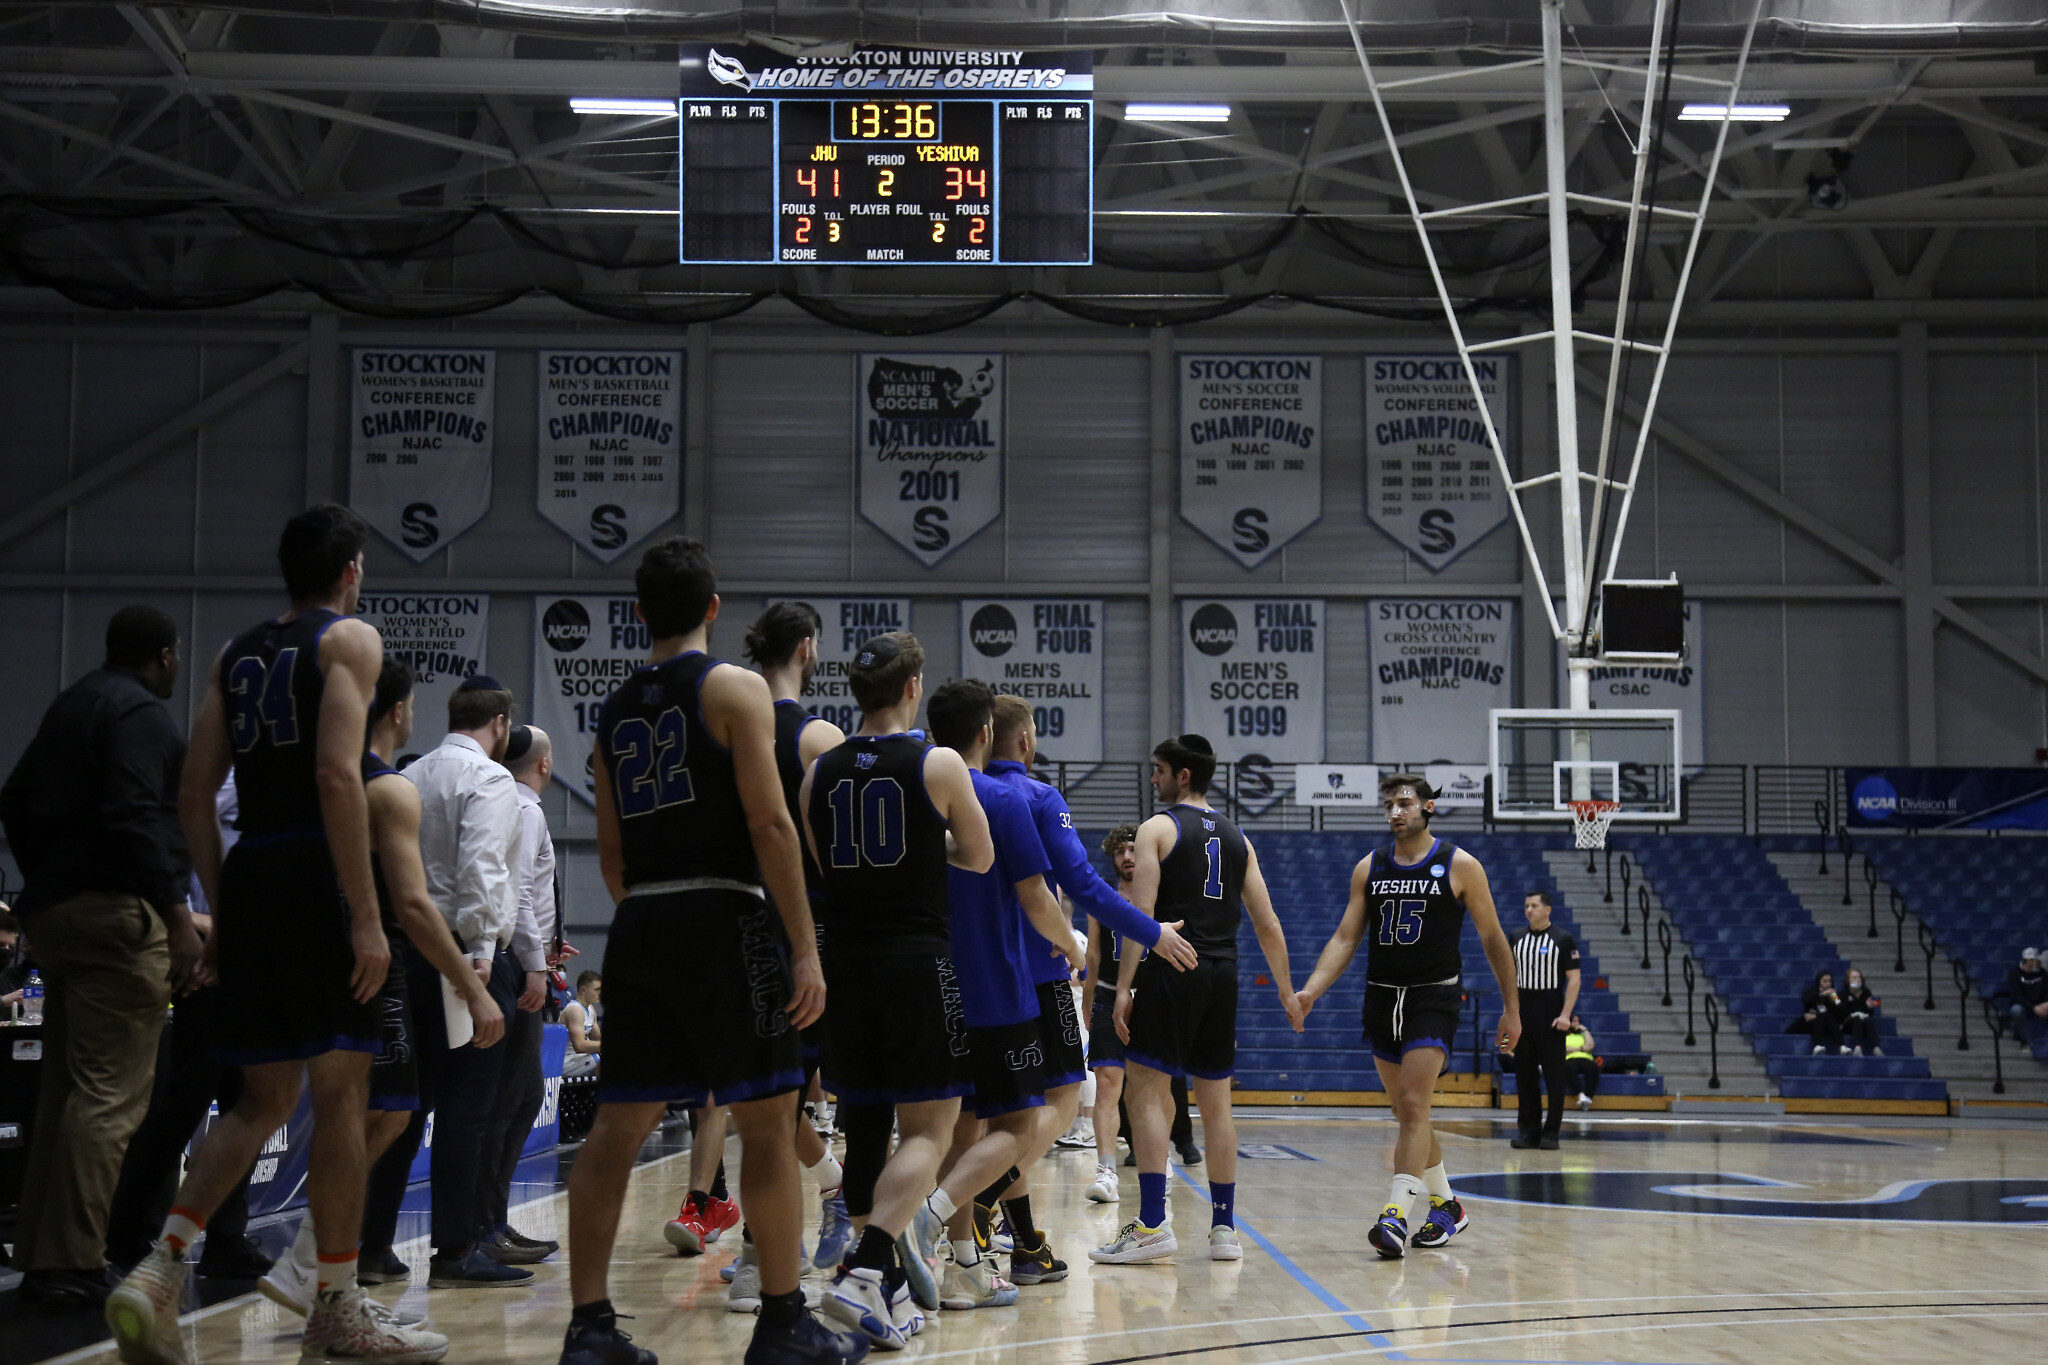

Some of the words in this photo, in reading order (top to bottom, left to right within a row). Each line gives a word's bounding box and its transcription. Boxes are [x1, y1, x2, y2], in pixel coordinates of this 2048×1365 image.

[796, 51, 901, 65] STOCKTON
[909, 51, 1023, 65] UNIVERSITY
[756, 67, 839, 88] HOME
[842, 68, 882, 88] OF
[885, 69, 940, 88] THE
[943, 69, 1067, 88] OSPREYS
[690, 104, 712, 118] PLYR
[721, 104, 738, 118] FLS
[748, 105, 766, 118] PTS
[1006, 106, 1028, 119] PLYR
[1037, 106, 1053, 119] FLS
[1065, 106, 1082, 119] PTS
[851, 104, 935, 138] 13:36
[811, 145, 838, 161] JHU
[867, 154, 906, 166] PERIOD
[916, 145, 980, 162] YESHIVA
[877, 170, 895, 197] 2
[945, 167, 986, 200] 34
[782, 203, 816, 215] FOULS
[850, 203, 890, 215] PLAYER
[896, 203, 923, 215] FOUL
[956, 204, 990, 216] FOULS
[795, 217, 812, 243] 2
[828, 222, 841, 243] 3
[932, 223, 946, 243] 2
[969, 217, 986, 244] 2
[782, 248, 817, 260] SCORE
[867, 249, 904, 260] MATCH
[956, 249, 991, 261] SCORE
[361, 353, 485, 374] STOCKTON
[548, 355, 671, 376] STOCKTON
[1189, 360, 1311, 380] STOCKTON
[1374, 360, 1497, 381] STOCKTON
[361, 375, 417, 388] WOMEN'S
[420, 376, 485, 388] BASKETBALL
[548, 378, 590, 390] MEN'S
[593, 379, 671, 391] BASKETBALL
[880, 370, 918, 382] NCAA
[920, 370, 936, 383] III
[883, 383, 932, 397] MEN'S
[1202, 383, 1243, 395] MEN'S
[1246, 383, 1300, 395] SOCCER
[1375, 383, 1430, 394] WOMEN'S
[1433, 383, 1497, 394] VOLLEYALL
[370, 391, 476, 405] CONFERENCE
[557, 393, 662, 407] CONFERENCE
[876, 397, 939, 410] SOCCER
[1198, 397, 1303, 411] CONFERENCE
[1384, 398, 1488, 412] CONFERENC
[361, 409, 487, 443] CHAMPIONS
[548, 411, 674, 445] CHAMPIONS
[868, 419, 996, 448] NATIONAL
[1190, 415, 1314, 449] CHAMPIONS
[402, 436, 442, 450] NJAC
[589, 438, 629, 451] NJAC
[1231, 442, 1271, 455] NJAC
[1417, 443, 1457, 457] NJAC
[877, 440, 988, 472] Champions
[899, 469, 960, 501] 2001
[355, 597, 479, 615] STOCKTON
[1379, 602, 1502, 621] STOCKTON
[384, 616, 450, 627] WOMEN'S
[840, 602, 902, 627] FINAL
[1033, 603, 1096, 628] FINAL
[1254, 603, 1317, 627] FINAL
[377, 627, 411, 638] RACK
[415, 627, 424, 638] &
[429, 627, 465, 638] FIELD
[547, 624, 590, 639] NCAA
[1407, 621, 1474, 633] WOMEN'S
[611, 625, 653, 650] FOU
[975, 629, 1016, 644] NCAA
[1036, 629, 1092, 653] FOUR
[1196, 628, 1237, 643] NCAA
[1257, 628, 1314, 653] FOUR
[1384, 632, 1429, 643] CROSS
[1432, 632, 1497, 643] COUNTRY
[384, 640, 457, 650] ONFERENCE
[1400, 645, 1481, 656] CONFERENCE
[393, 651, 479, 679] MPIONS
[554, 658, 645, 677] WOMEN'
[1005, 662, 1062, 678] MEN'S
[1221, 661, 1288, 680] MEN'S
[1378, 656, 1504, 685] CHAMPIONS
[560, 678, 622, 697] SOCC
[989, 682, 1092, 698] ASKETBALL
[1210, 681, 1299, 700] SOCCER
[1421, 677, 1461, 689] NJAC
[1609, 683, 1651, 695] CSAC
[229, 646, 300, 753] 34
[1224, 704, 1287, 736] 1999
[611, 705, 696, 820] 22
[1858, 797, 1897, 809] NCAA
[1900, 798, 1945, 809] Division
[828, 777, 907, 868] 10
[1059, 812, 1073, 830] 32
[1201, 817, 1216, 832] YU
[1203, 836, 1224, 900] 1
[1371, 880, 1442, 896] YESHIVA
[1379, 899, 1428, 946] 15
[739, 908, 790, 1040] MACS
